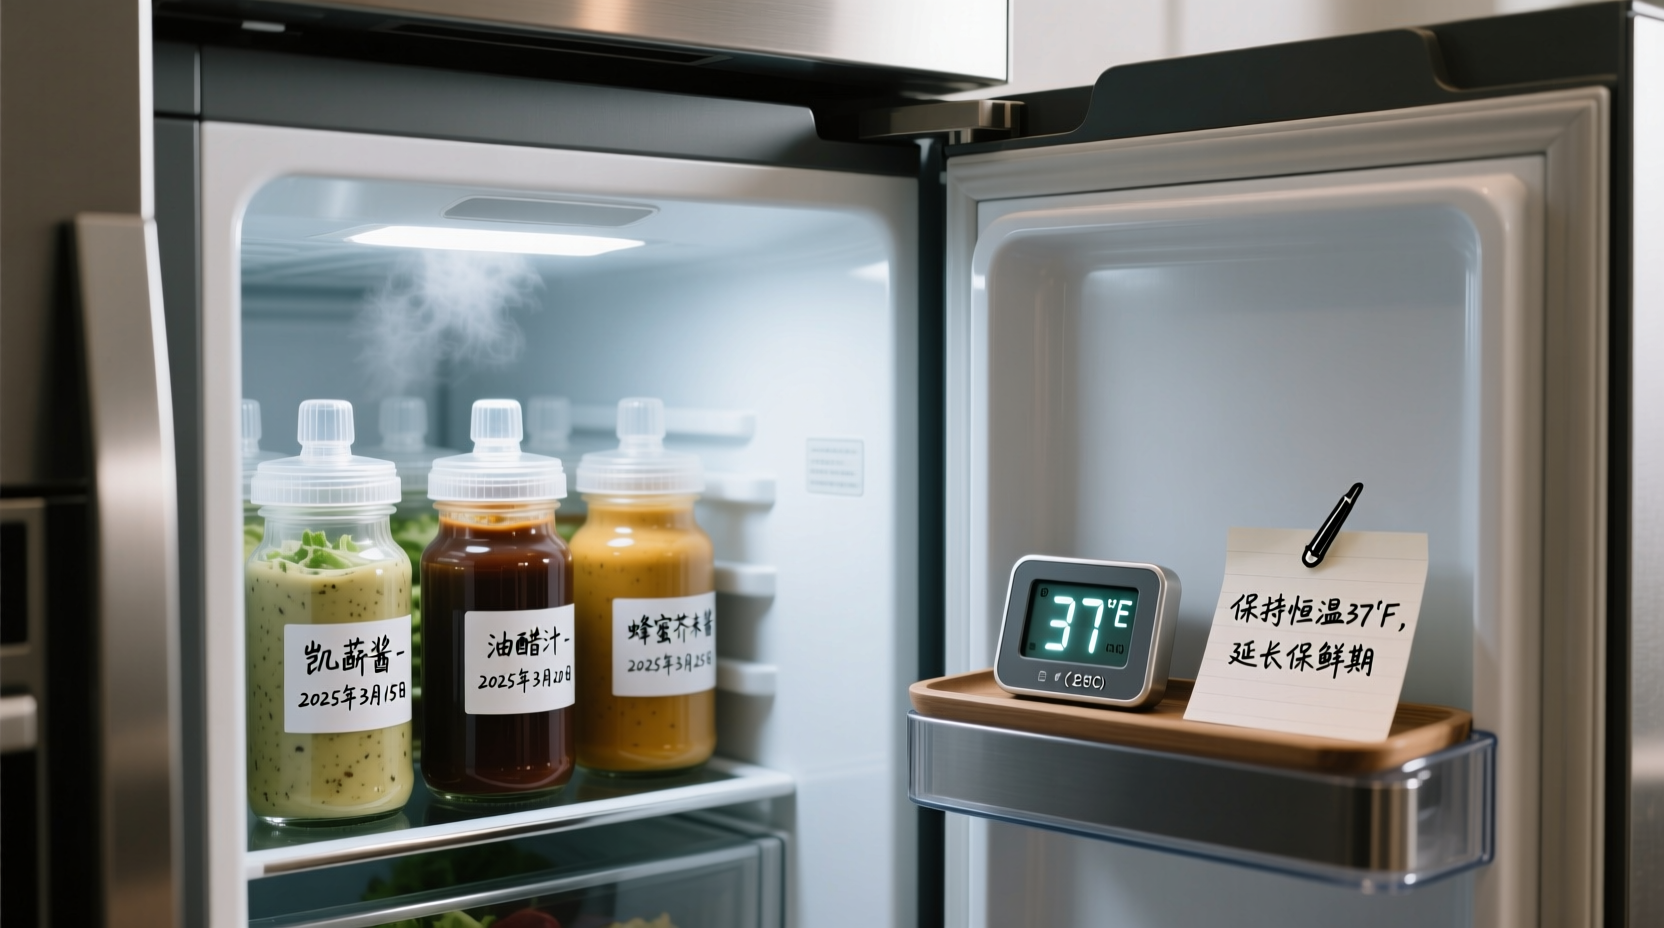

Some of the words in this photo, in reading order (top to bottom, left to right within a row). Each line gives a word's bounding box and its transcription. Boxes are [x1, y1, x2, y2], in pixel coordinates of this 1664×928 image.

[1228, 640, 1375, 679] 延长保鲜期
[478, 665, 571, 694] 2025年3月20日
[298, 681, 406, 711] 2025年3月15日
